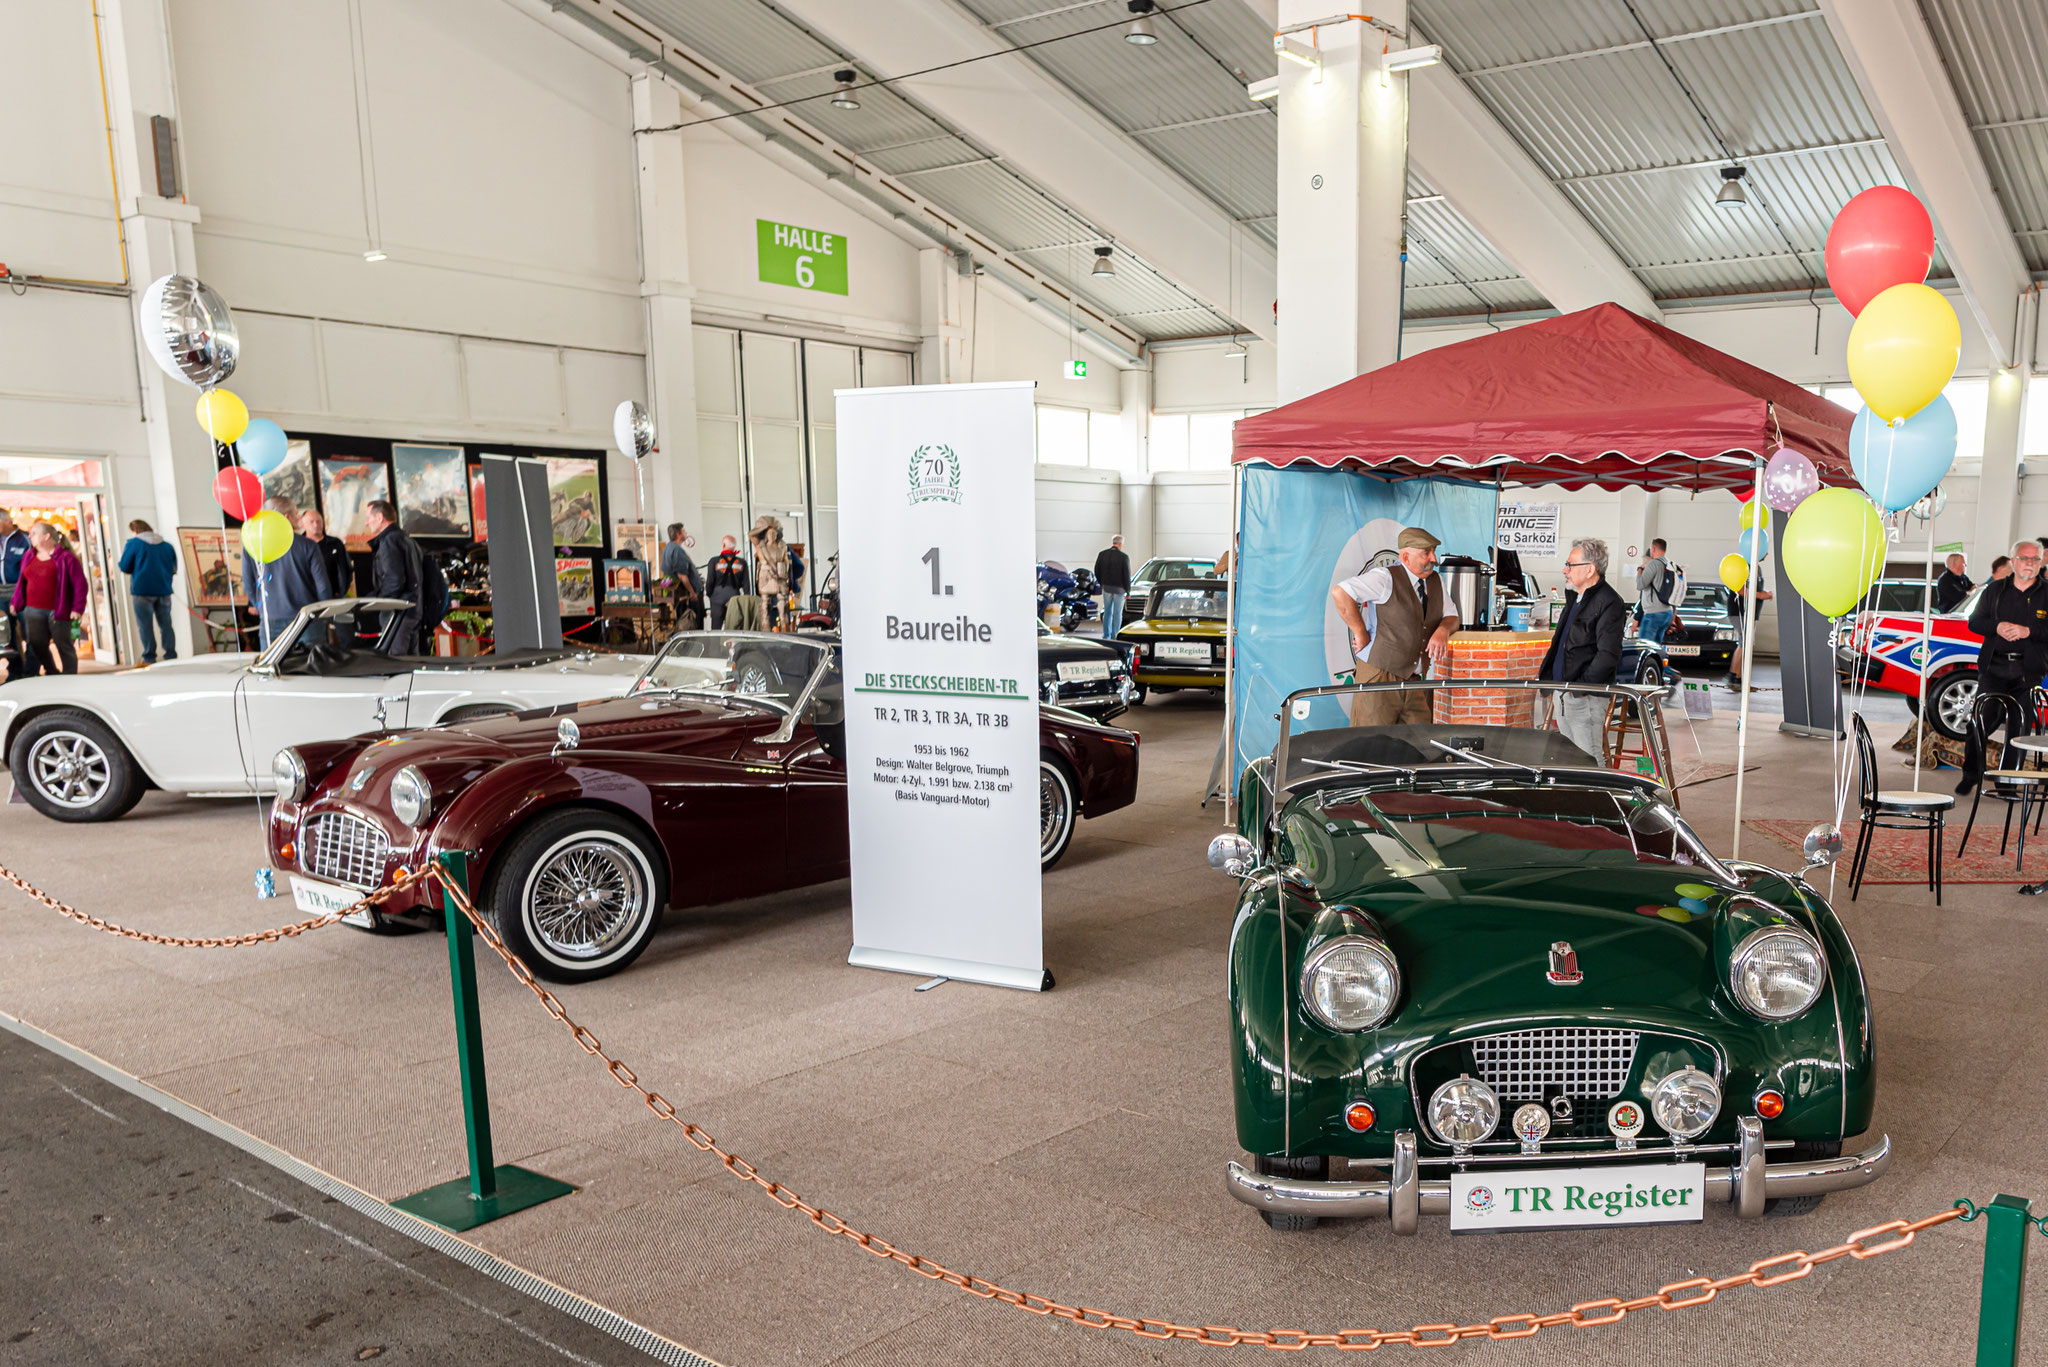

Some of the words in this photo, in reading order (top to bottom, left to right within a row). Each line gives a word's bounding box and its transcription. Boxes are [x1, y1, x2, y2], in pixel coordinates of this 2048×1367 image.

[774, 224, 833, 255] HALLE
[795, 255, 815, 288] 6
[925, 459, 944, 475] 70
[924, 476, 944, 484] JAHRE
[915, 487, 945, 497] TRIUMPH
[1498, 507, 1517, 515] AR
[1513, 531, 1556, 544] Sarközi
[921, 547, 954, 596] 1.
[886, 615, 992, 643] Baureihe
[1166, 646, 1179, 654] TR
[1179, 646, 1209, 656] Register
[1070, 666, 1081, 675] TR
[1081, 665, 1107, 676] Register
[865, 673, 886, 688] DIE
[889, 673, 1018, 694] STECKSCHEIBEN-TR
[1684, 682, 1698, 691] TR
[1701, 684, 1709, 692] 6
[874, 707, 887, 720] TR
[890, 709, 900, 723] 2,
[904, 709, 918, 722] TR
[922, 710, 932, 725] 3,
[935, 711, 950, 724] TR
[953, 711, 972, 728] 3A,
[976, 713, 990, 726] TR
[993, 714, 1009, 728] 3B
[914, 744, 933, 755] 1953
[934, 745, 947, 756] bis
[949, 746, 969, 757] 1962
[876, 757, 904, 771] Design:
[906, 759, 933, 771] Walter
[935, 761, 973, 775] Belgrove,
[976, 764, 1009, 778] Triumph
[873, 772, 899, 784] Motor:
[901, 775, 926, 788] 4-Zyl.,
[928, 776, 949, 787] 1.991
[952, 778, 971, 789] bzw.
[974, 780, 995, 791] 2.138
[997, 782, 1013, 792] cm³
[895, 789, 919, 801] (Basis
[920, 791, 990, 808] Vanguard-Motor)
[306, 889, 323, 908] TR
[1504, 1186, 1554, 1213] TR
[1562, 1183, 1694, 1217] Register
